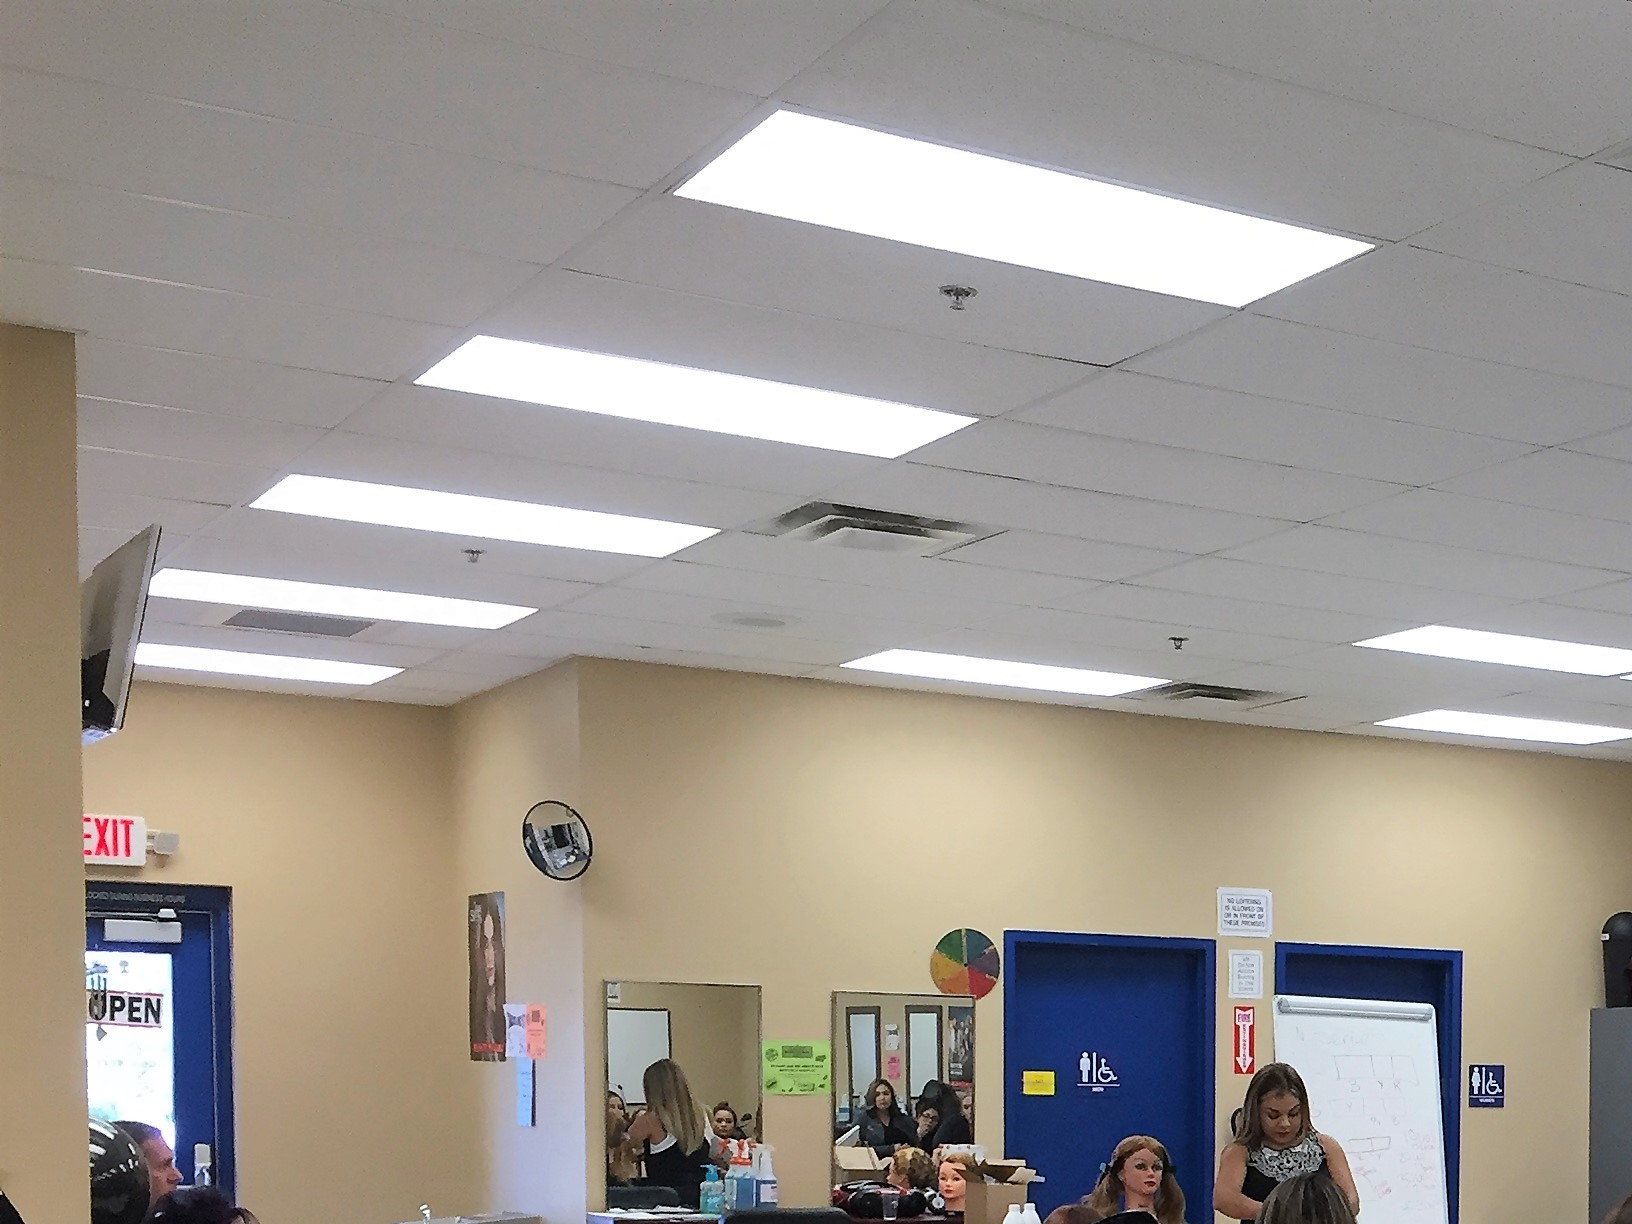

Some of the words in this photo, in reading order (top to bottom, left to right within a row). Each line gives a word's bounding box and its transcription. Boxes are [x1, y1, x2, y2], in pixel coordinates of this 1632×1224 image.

[83, 816, 134, 857] EXIT
[89, 995, 162, 1025] OPEN
[1237, 1013, 1251, 1022] FIRE
